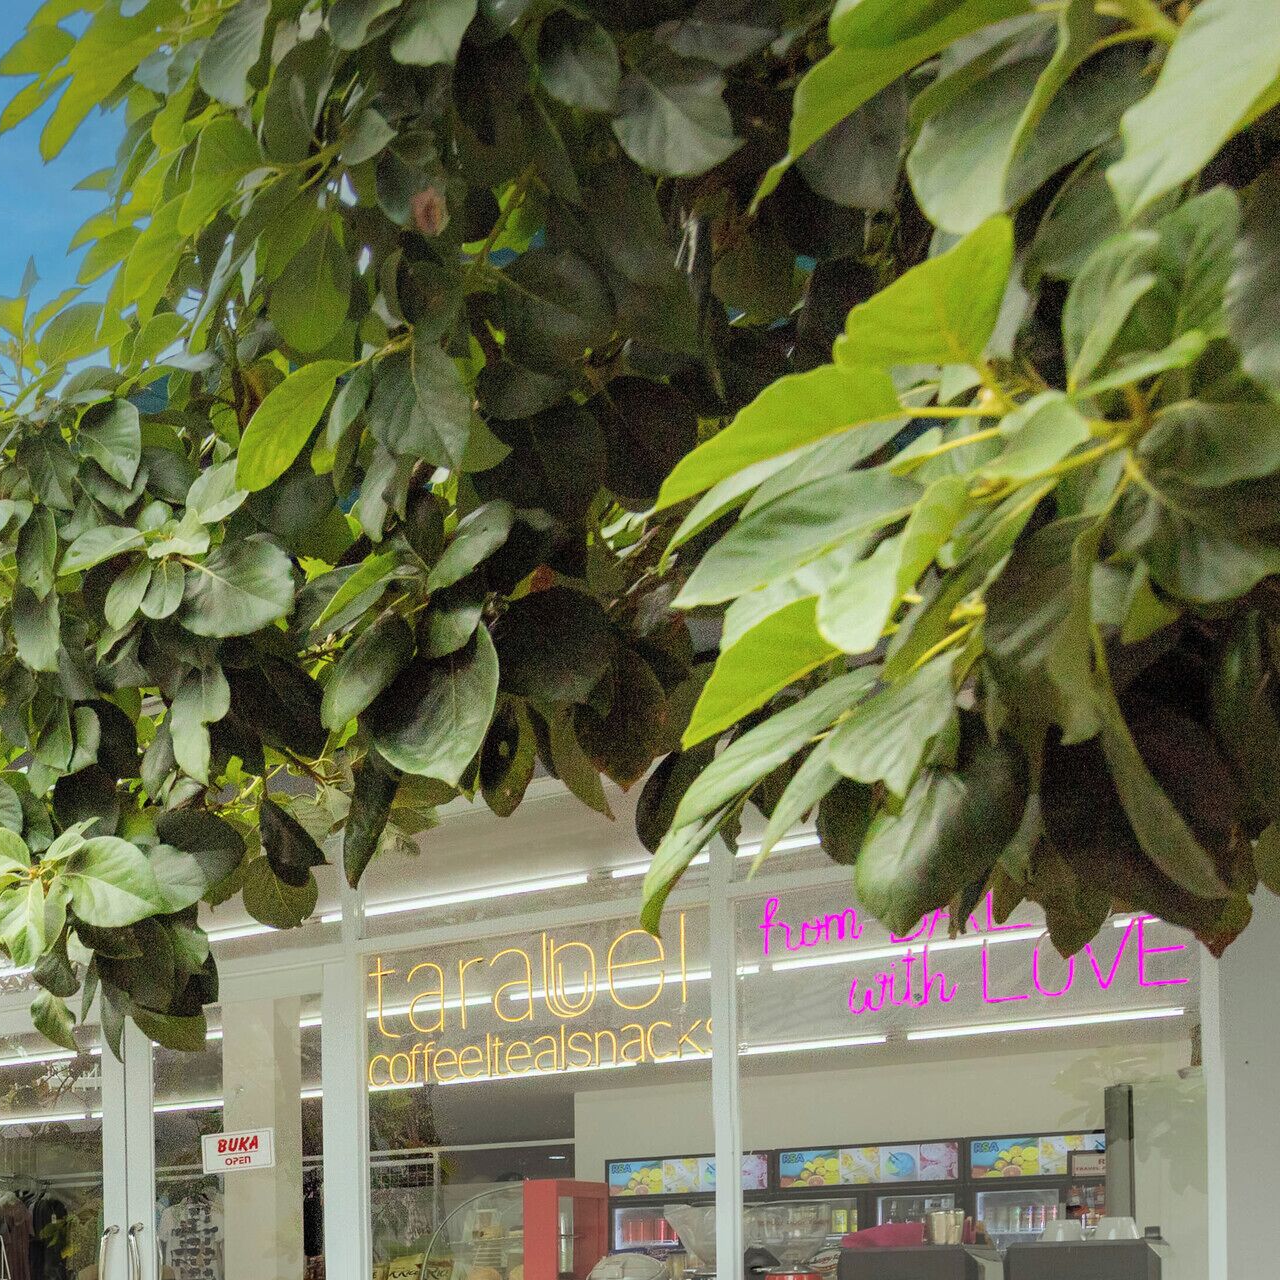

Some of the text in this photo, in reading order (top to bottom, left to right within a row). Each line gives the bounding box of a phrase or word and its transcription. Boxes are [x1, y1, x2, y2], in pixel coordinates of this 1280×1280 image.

[759, 897, 863, 957] from
[849, 914, 1189, 1014] with LOVE
[217, 1135, 259, 1153] BUKA
[225, 1155, 251, 1166] OPEN
[611, 1163, 632, 1175] RSA
